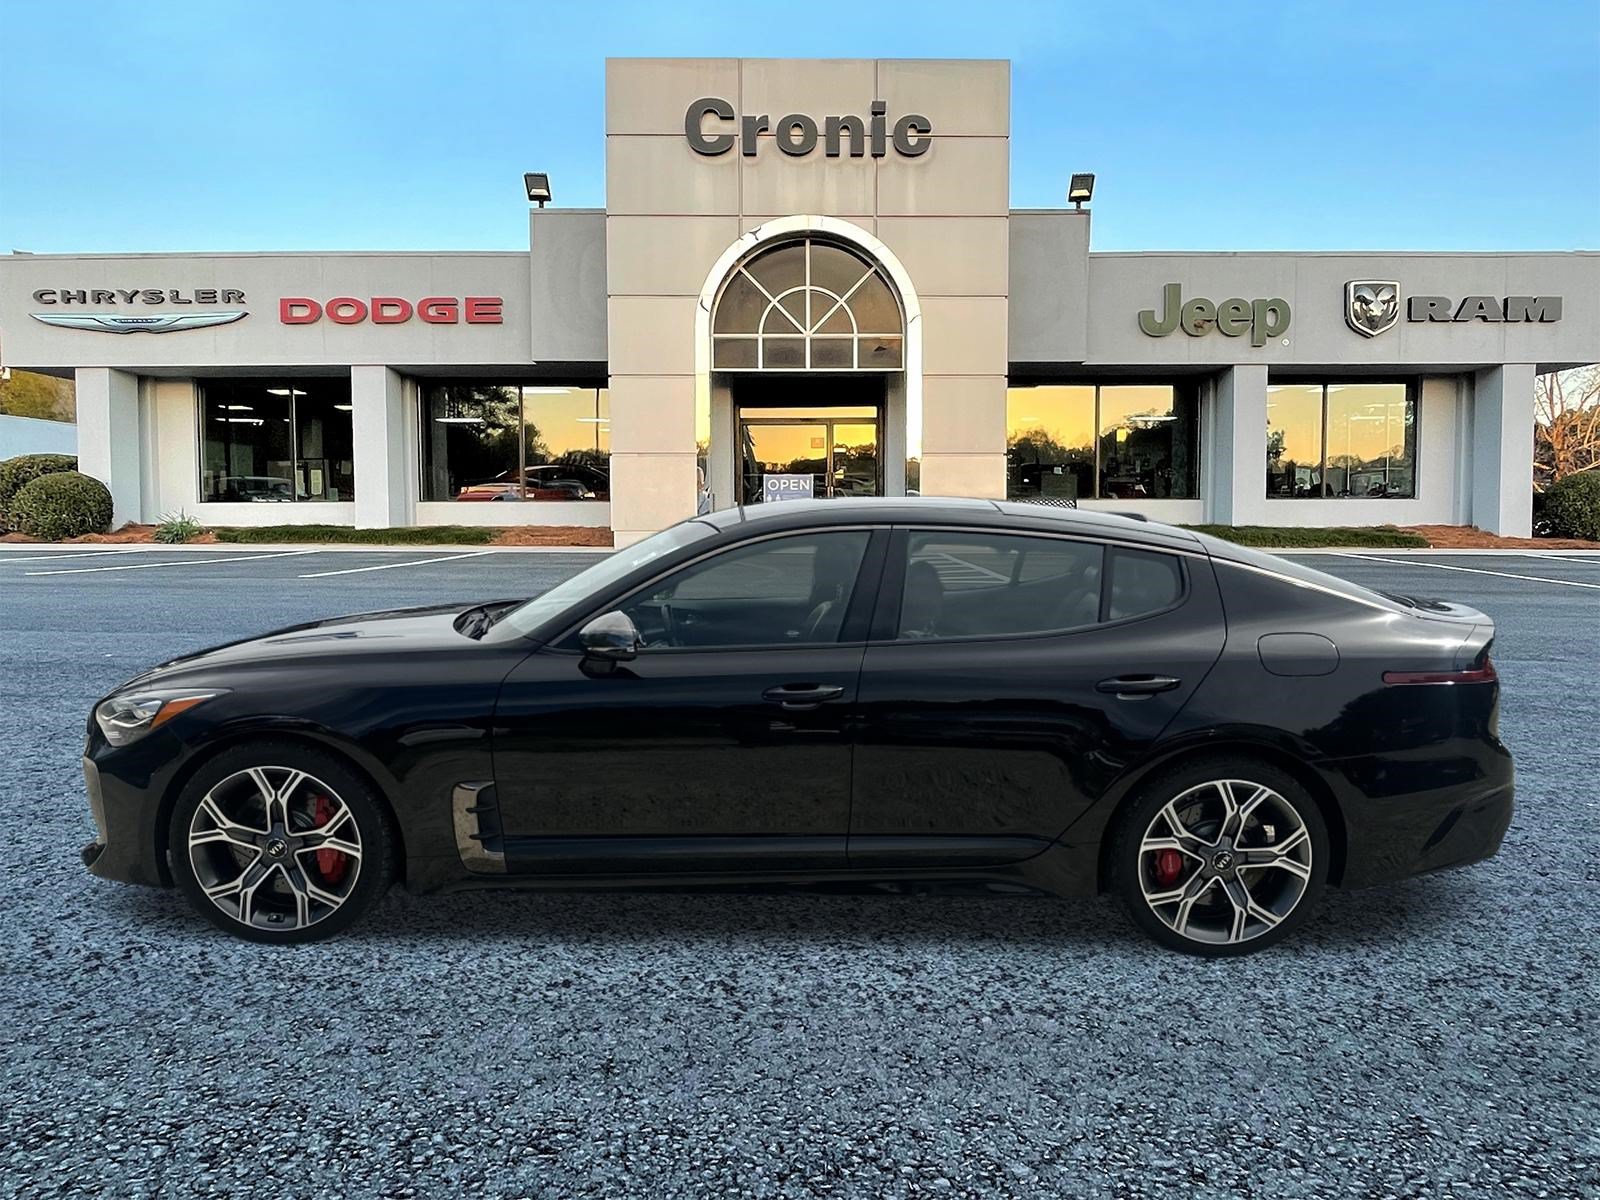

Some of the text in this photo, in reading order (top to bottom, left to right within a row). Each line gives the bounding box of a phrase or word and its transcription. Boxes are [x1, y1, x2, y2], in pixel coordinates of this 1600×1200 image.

[685, 97, 932, 157] Cronic
[32, 288, 246, 304] CHRYSLER
[1407, 296, 1562, 323] RAM
[280, 297, 503, 325] DODGE
[1138, 283, 1291, 347] Jeep
[768, 479, 810, 490] OPEN
